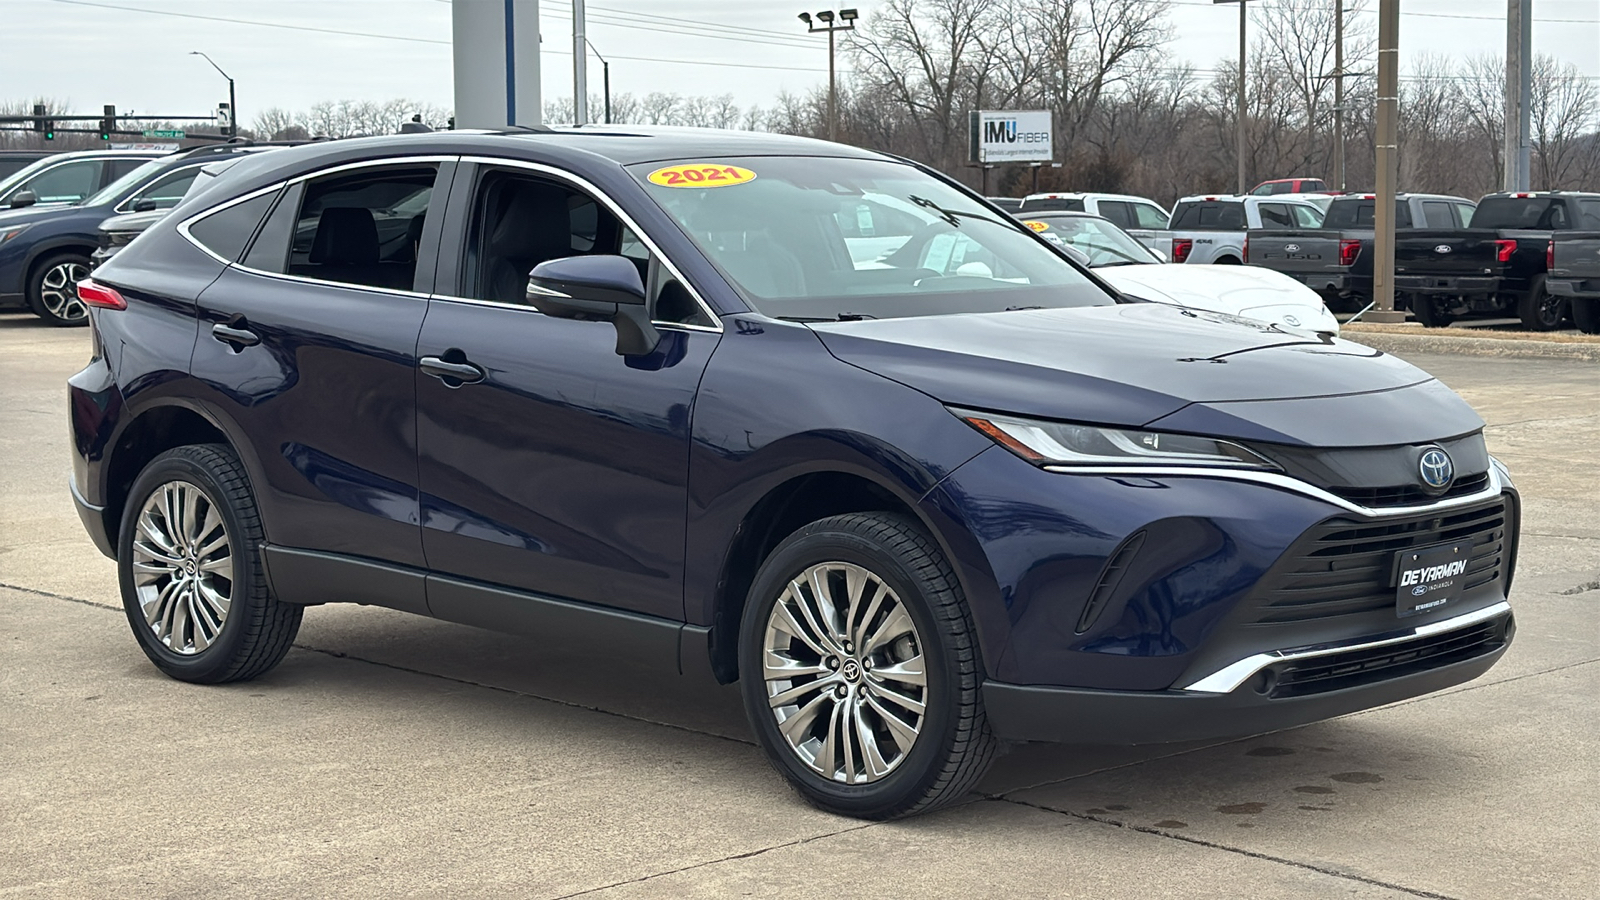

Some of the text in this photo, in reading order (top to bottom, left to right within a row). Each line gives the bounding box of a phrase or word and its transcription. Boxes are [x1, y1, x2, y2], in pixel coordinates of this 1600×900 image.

[984, 121, 1049, 143] IMU FIBER
[661, 167, 743, 185] 2021
[1428, 580, 1454, 591] INDIANOLA
